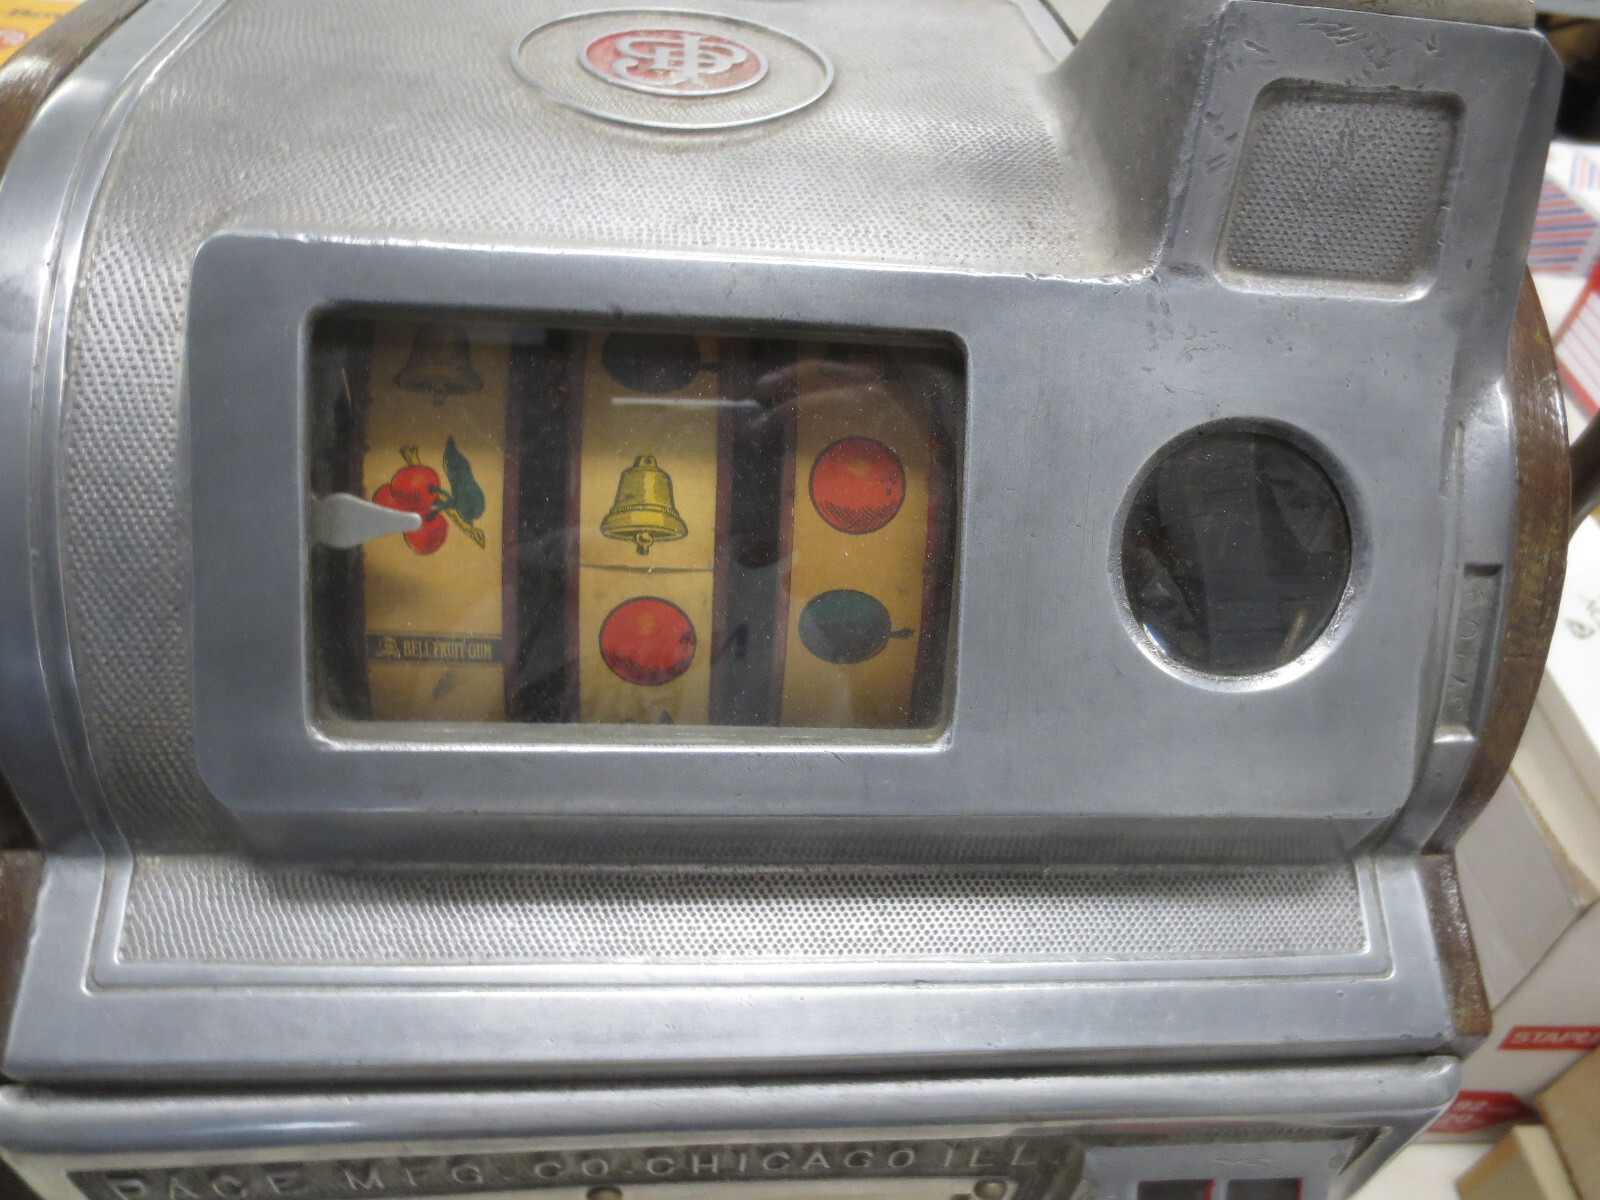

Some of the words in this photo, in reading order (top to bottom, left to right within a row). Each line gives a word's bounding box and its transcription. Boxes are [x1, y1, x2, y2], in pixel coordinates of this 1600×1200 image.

[403, 640, 429, 658] BELL
[434, 641, 466, 659] FRUIT
[468, 642, 492, 660] GUM
[111, 1172, 307, 1200] PACE
[646, 1149, 914, 1174] CHICAGO
